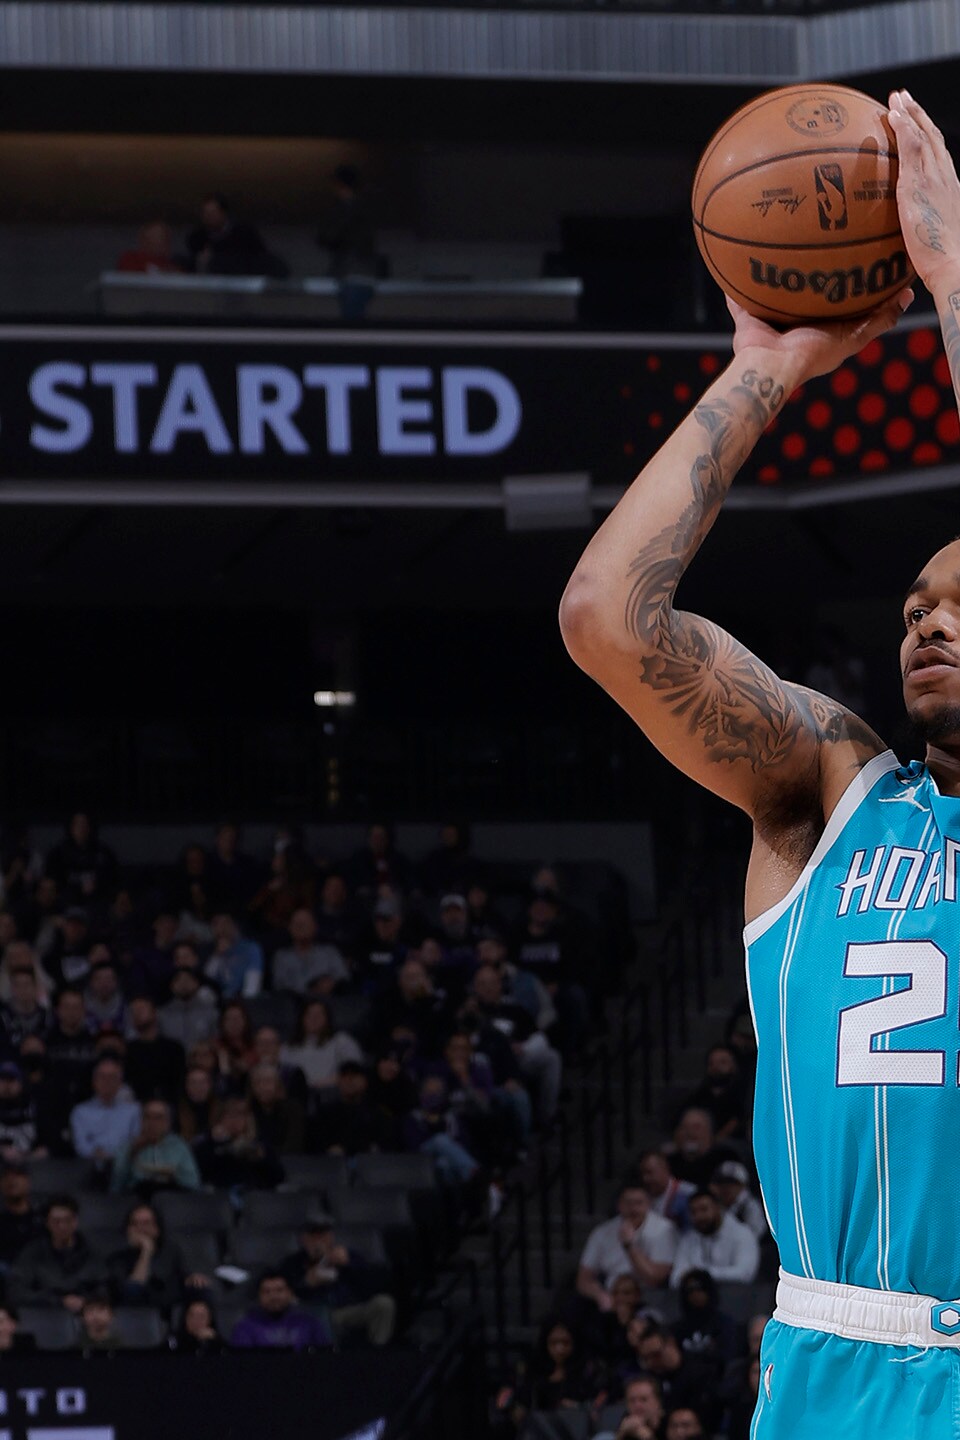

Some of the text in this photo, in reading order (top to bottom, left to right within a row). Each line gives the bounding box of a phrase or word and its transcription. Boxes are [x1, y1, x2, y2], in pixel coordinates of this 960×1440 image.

[749, 251, 909, 304] Wilson
[28, 361, 523, 456] STARTED
[0, 1387, 86, 1416] TO
